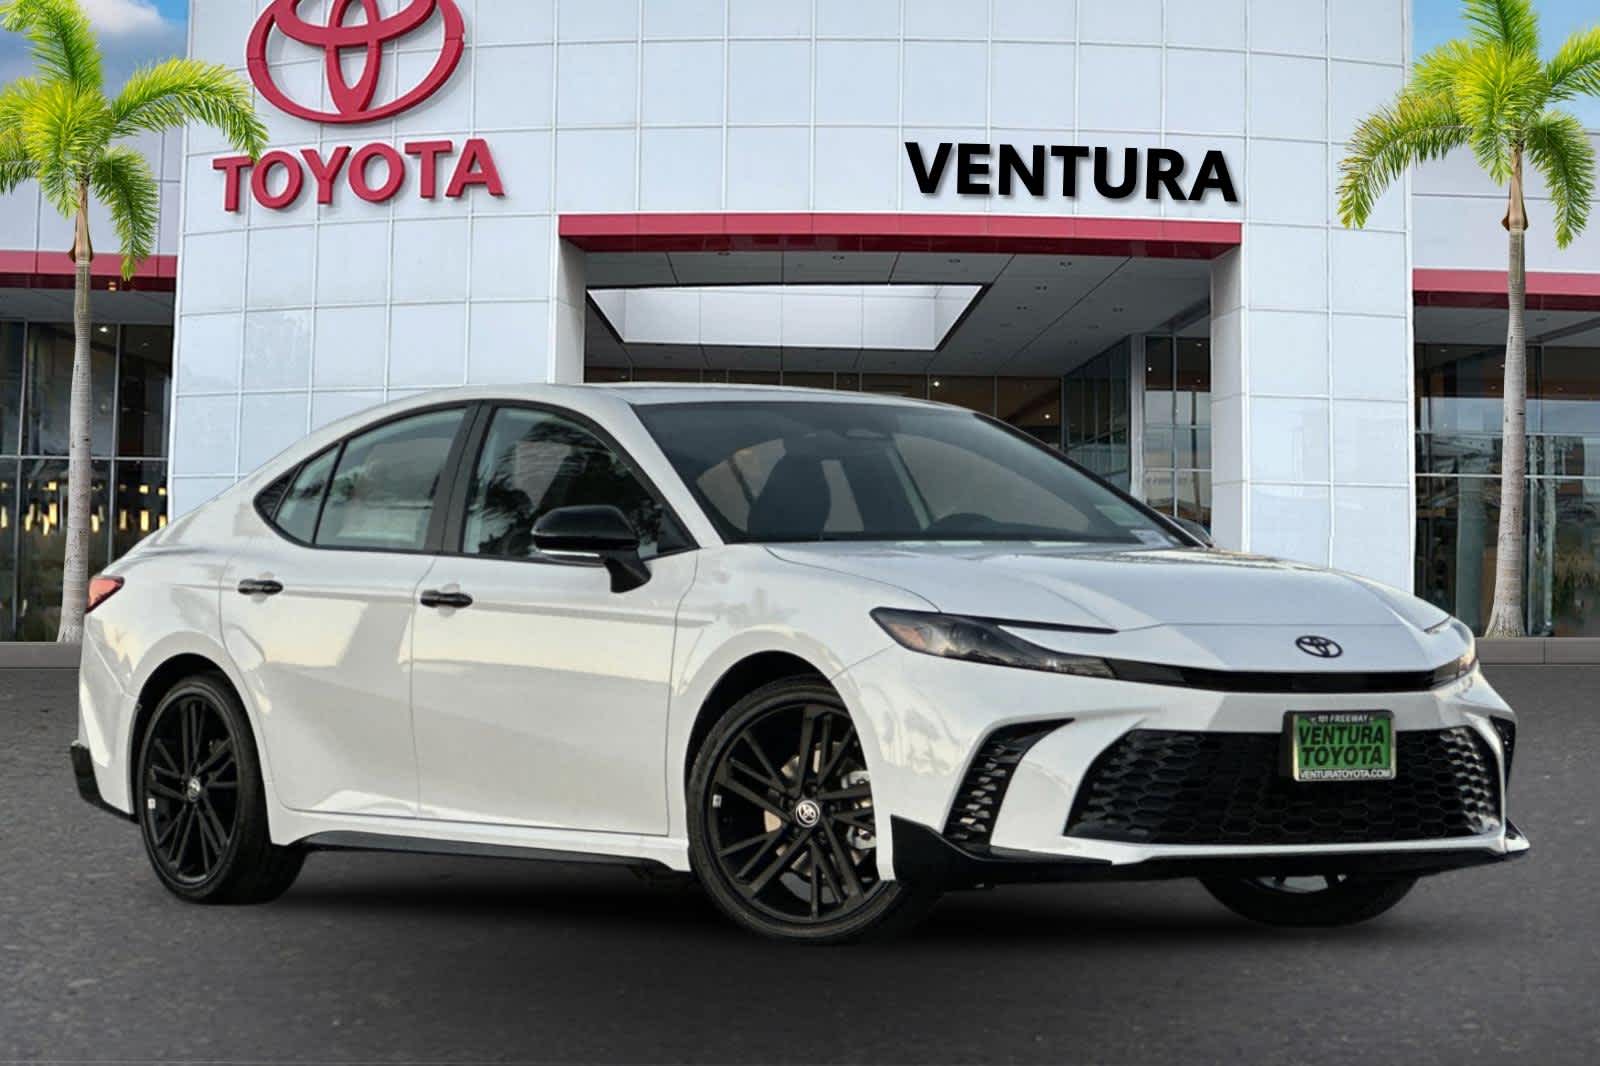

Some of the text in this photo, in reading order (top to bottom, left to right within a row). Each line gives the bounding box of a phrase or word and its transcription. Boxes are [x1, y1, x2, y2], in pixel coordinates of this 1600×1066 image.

[213, 139, 505, 212] TOYOTA
[905, 142, 1241, 202] VENTURA
[1299, 725, 1384, 745] VENTURA
[1302, 746, 1383, 766] TOYOTA
[1301, 769, 1391, 778] VENTURATOYOTA.COM
